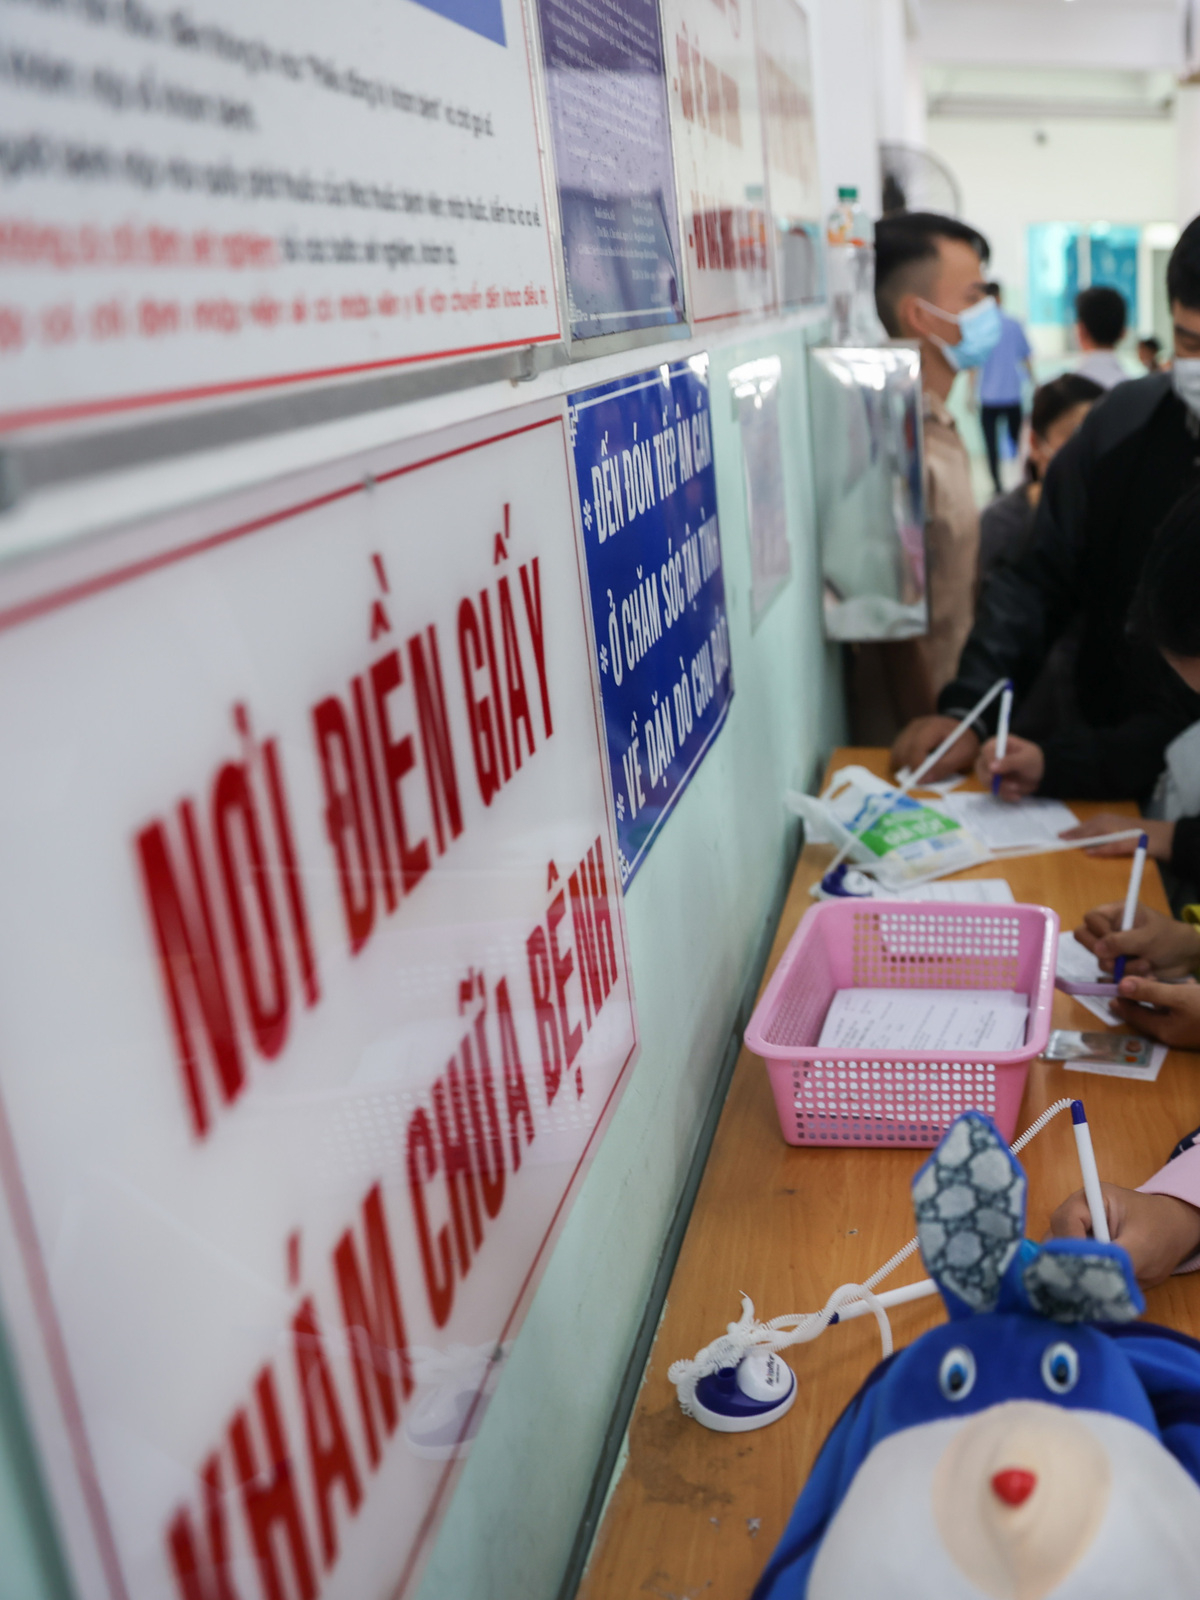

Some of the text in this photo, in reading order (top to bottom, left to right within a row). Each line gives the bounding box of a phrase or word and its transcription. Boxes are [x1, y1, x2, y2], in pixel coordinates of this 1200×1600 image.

[591, 430, 624, 544] ĐẾN
[622, 422, 655, 522] ĐÓN
[652, 404, 677, 501] TIẾP
[676, 402, 693, 484] ÂN
[607, 506, 720, 686] Ở CHĂM SÓC TẬN TÌNH
[622, 710, 647, 820] VỀ
[644, 690, 675, 788] DẶN
[673, 655, 693, 747] DÒ
[691, 640, 714, 718] CHU
[134, 503, 553, 1143] NƠI ĐIỀN GIẤY
[406, 966, 535, 1330] CHỮA
[526, 835, 618, 1106] BỆNH
